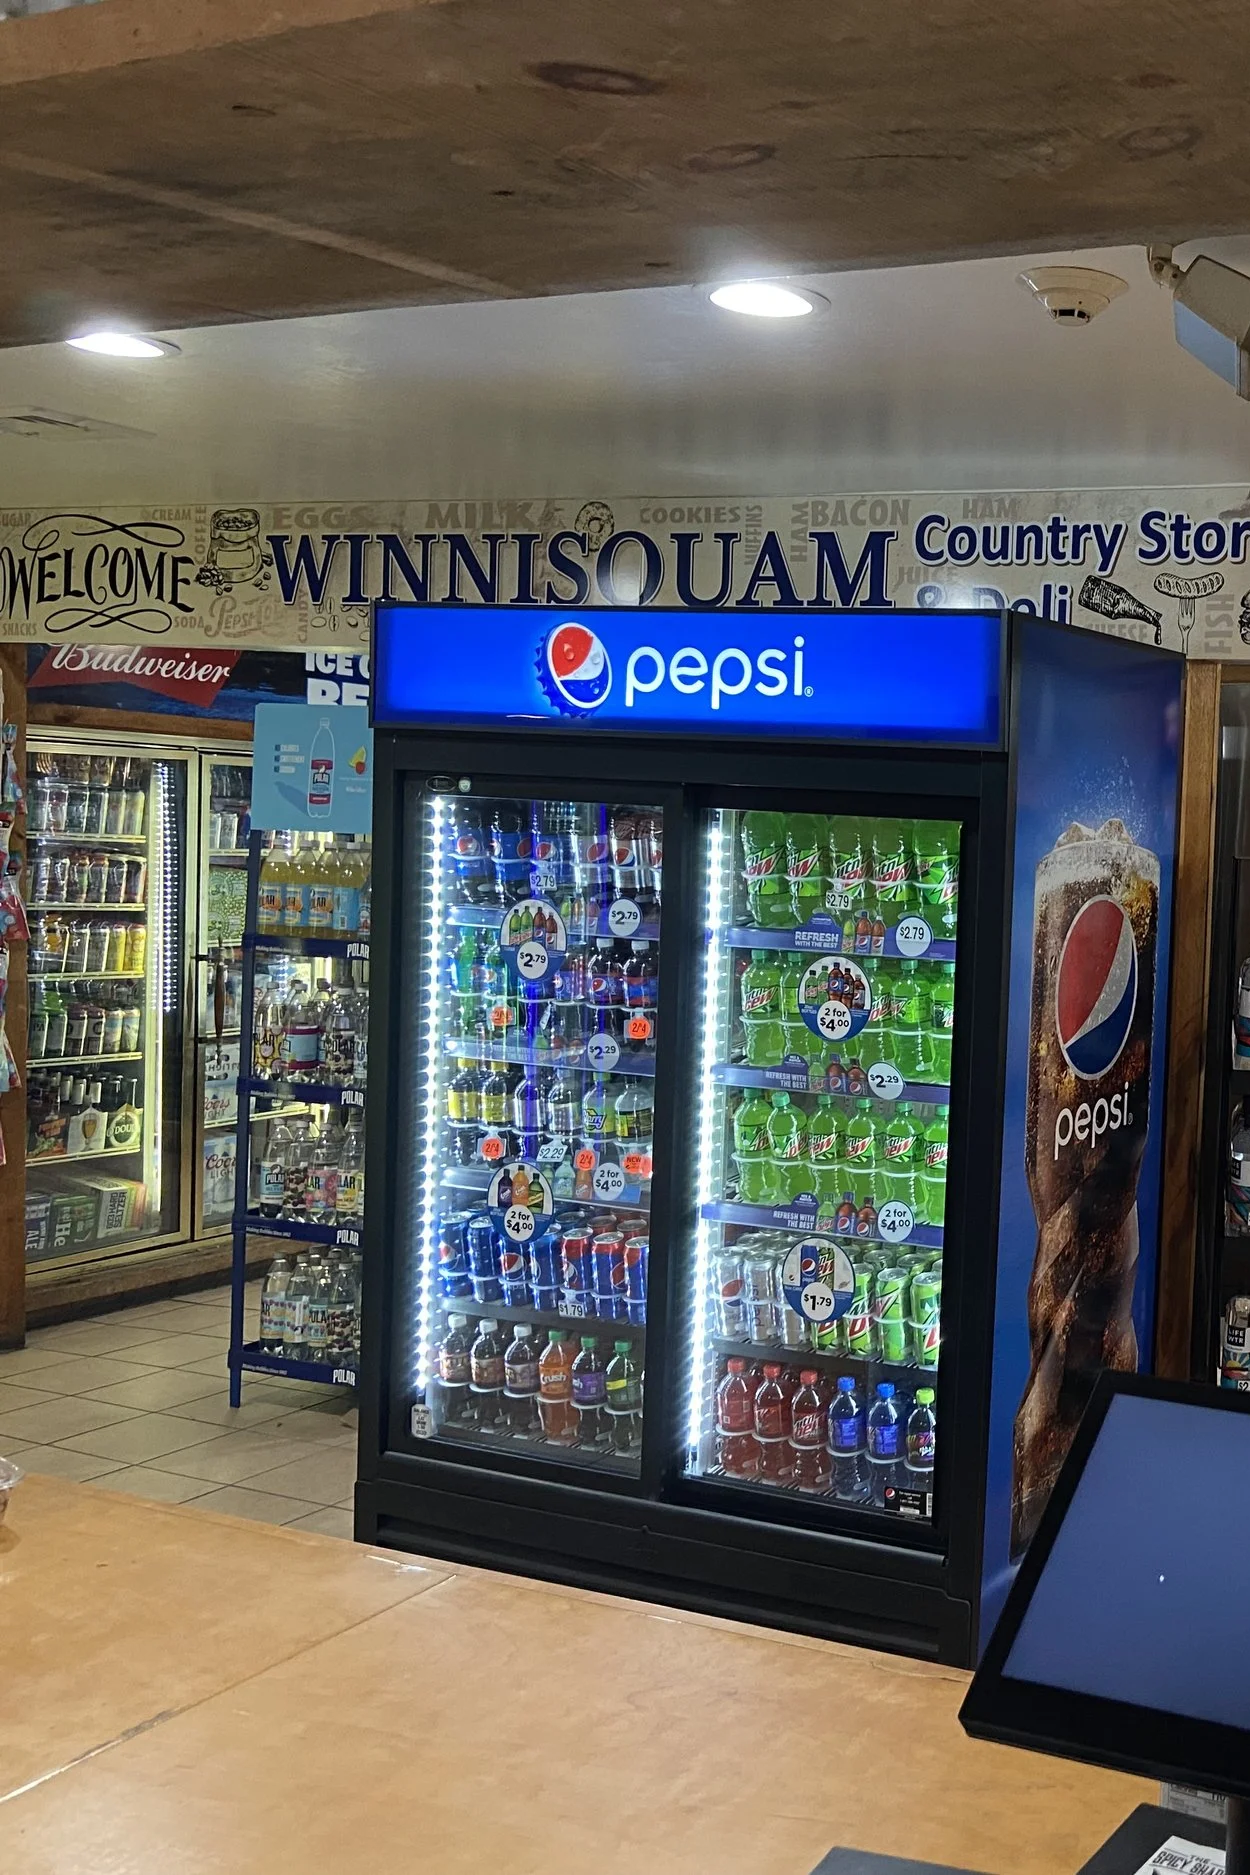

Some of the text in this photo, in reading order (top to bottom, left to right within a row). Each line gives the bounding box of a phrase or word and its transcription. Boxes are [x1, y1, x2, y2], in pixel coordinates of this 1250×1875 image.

[425, 502, 540, 532] MILK
[639, 505, 741, 524] COOKIES
[810, 499, 912, 526] BACON
[961, 499, 1022, 519] HAM
[913, 511, 1128, 577] Country
[265, 530, 899, 608] WINNISQUAM
[0, 540, 196, 621] WELCOME
[915, 583, 951, 608] &
[1204, 594, 1235, 655] FISH
[51, 643, 232, 684] Budweiser
[304, 651, 352, 677] ICE
[624, 635, 806, 710] pepsi
[530, 874, 557, 888] $2.79
[825, 893, 850, 908] $2.79
[611, 910, 639, 926] $2.79
[794, 931, 840, 943] REFRESH
[899, 926, 926, 941] $2.79
[346, 943, 370, 959] POLAR
[519, 952, 547, 968] $2.79
[824, 1007, 831, 1017] 2
[832, 1007, 847, 1017] for
[819, 1017, 850, 1033] $4.00
[589, 1044, 617, 1061] $2.29
[869, 1073, 899, 1089] $2.29
[340, 1090, 364, 1106] POLAR
[1053, 1082, 1130, 1162] pepsi
[538, 1145, 565, 1159] $2.29
[599, 1169, 620, 1179] 2 for
[595, 1178, 623, 1193] $4.00
[510, 1211, 531, 1221] 2 for
[885, 1208, 908, 1218] 2 for
[506, 1219, 533, 1234] $4.00
[880, 1218, 912, 1234] $4.00
[336, 1229, 360, 1247] POLAR
[559, 1302, 584, 1317] $1.79
[803, 1293, 832, 1311] $1.79
[332, 1369, 356, 1387] POLAR
[1152, 1850, 1191, 1870] SPICY
[1189, 1854, 1211, 1865] THE
